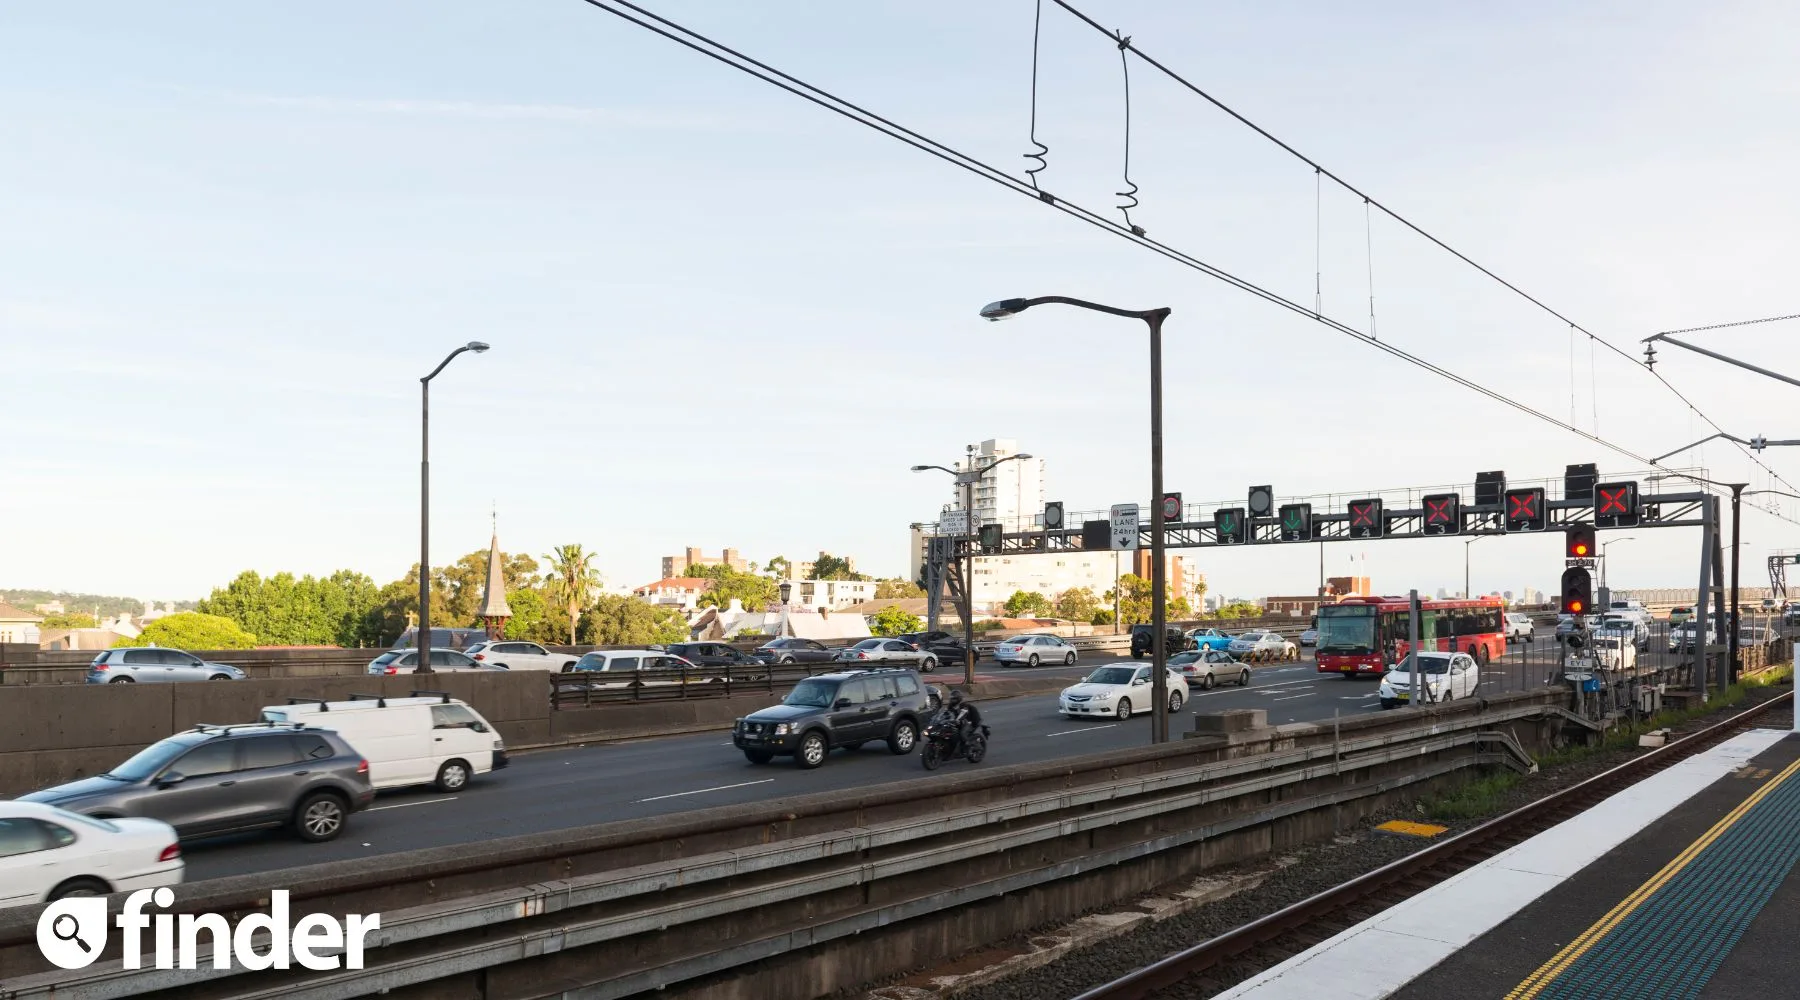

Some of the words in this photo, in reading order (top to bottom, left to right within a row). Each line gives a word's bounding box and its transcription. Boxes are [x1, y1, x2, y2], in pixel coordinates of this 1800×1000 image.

[1438, 525, 1445, 534] 3
[1520, 521, 1530, 531] 2
[1292, 531, 1300, 540] 5
[1361, 527, 1370, 538] 4
[1227, 534, 1234, 544] 6
